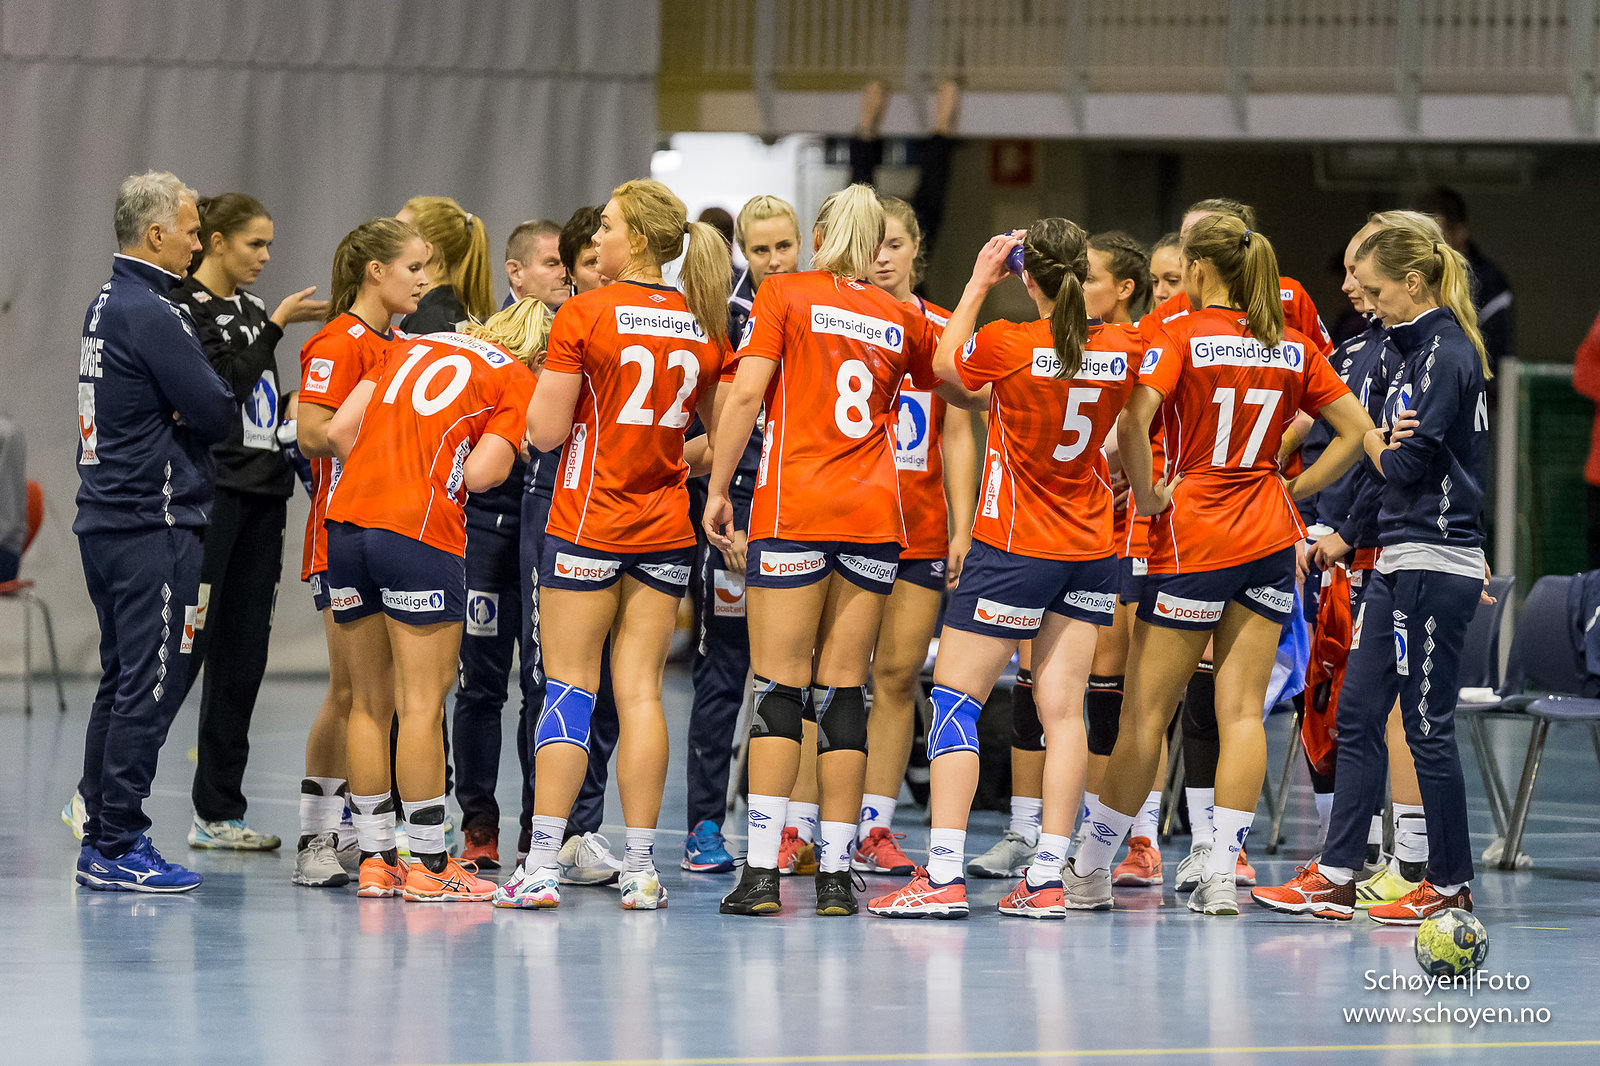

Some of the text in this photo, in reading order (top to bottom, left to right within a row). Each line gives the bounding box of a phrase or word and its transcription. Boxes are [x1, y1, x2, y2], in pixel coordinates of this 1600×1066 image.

[619, 312, 691, 334] Gjensidige
[814, 312, 882, 339] Gjensidige
[1195, 342, 1281, 364] Gjensidige
[1035, 355, 1109, 376] Gjedige
[382, 343, 472, 417] 10
[615, 344, 701, 429] 22
[834, 359, 874, 439] 8
[1052, 387, 1103, 462] 5
[1211, 387, 1284, 468] 17
[565, 442, 579, 488] posten
[895, 455, 925, 467] nsidige
[779, 556, 827, 575] posten
[996, 611, 1041, 627] posten
[1173, 606, 1222, 620] posten
